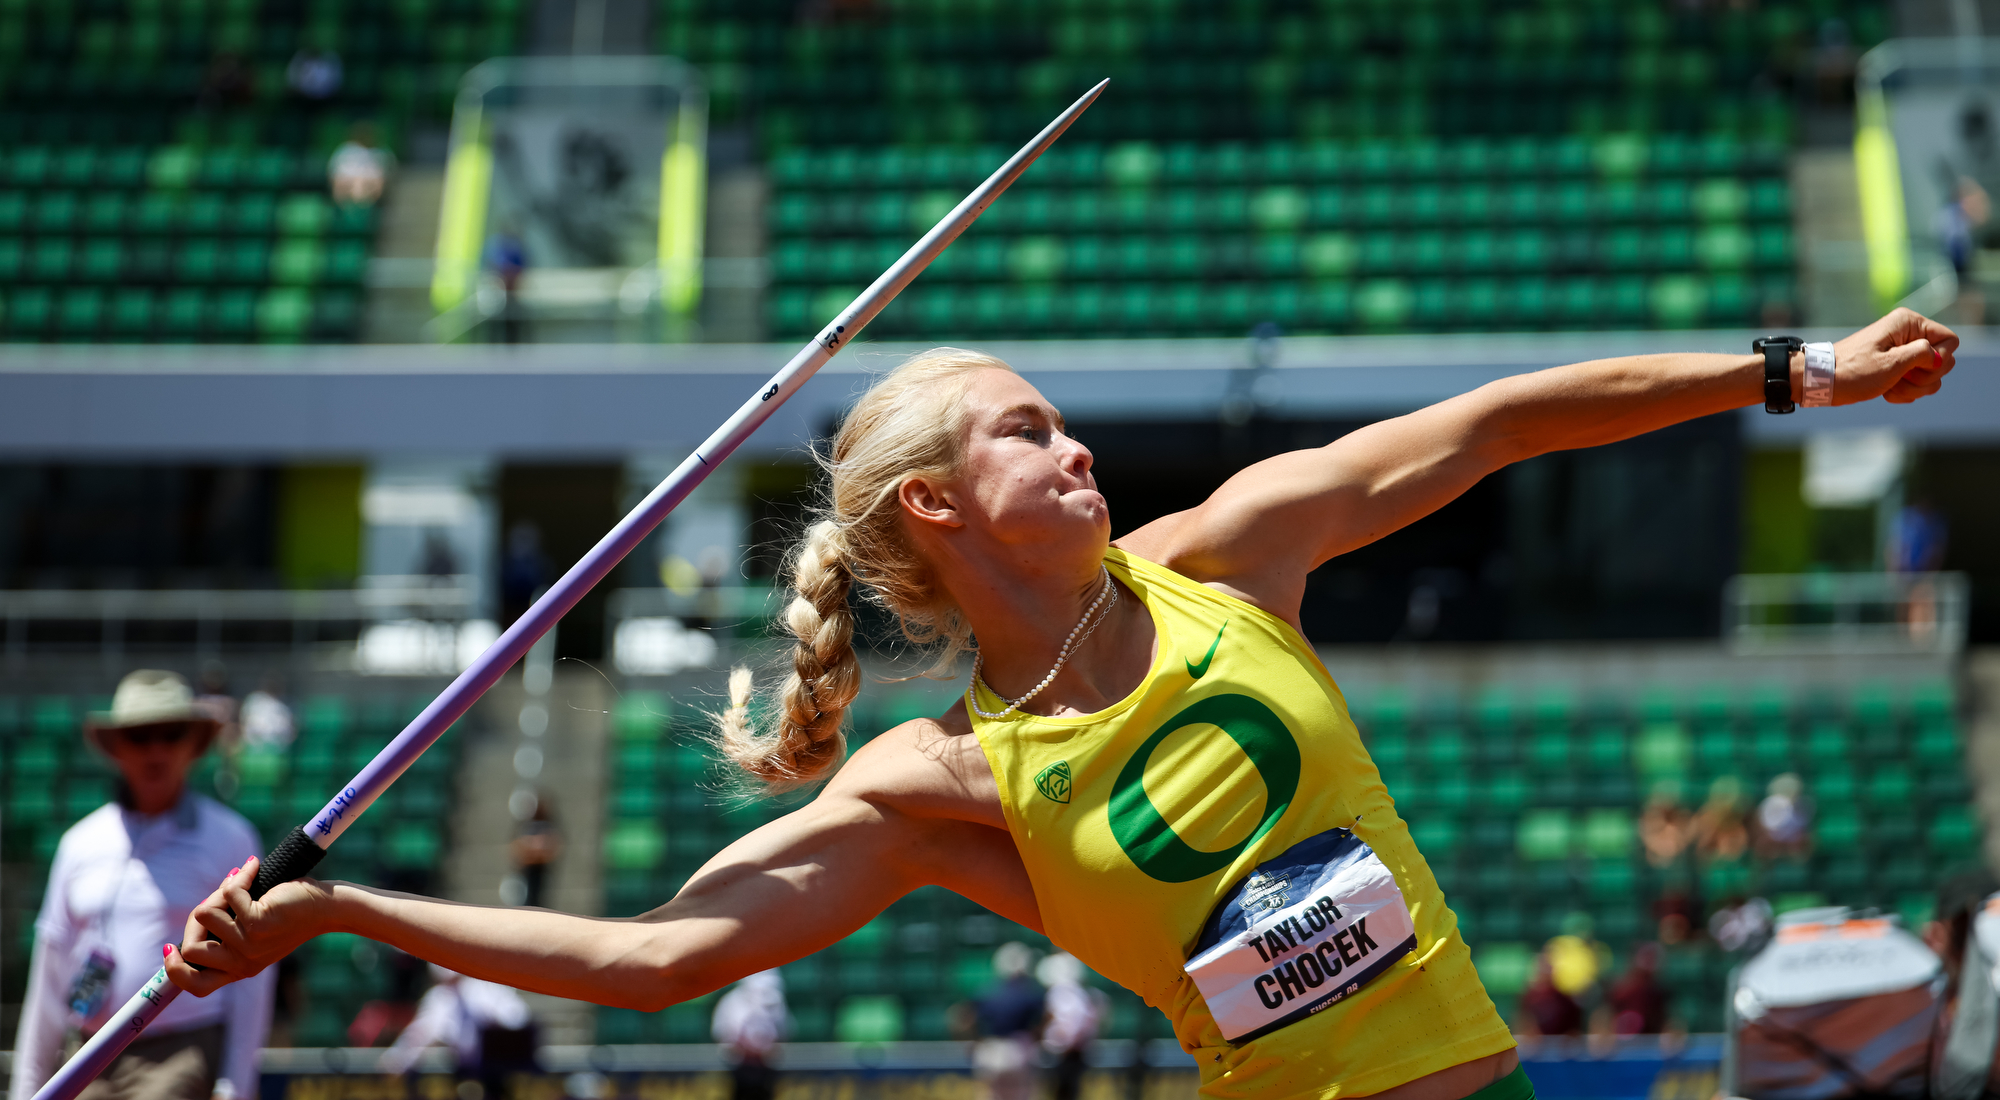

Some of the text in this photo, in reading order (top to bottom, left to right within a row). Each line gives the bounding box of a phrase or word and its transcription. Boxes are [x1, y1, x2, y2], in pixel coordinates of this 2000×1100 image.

[1036, 762, 1069, 796] PAC
[1049, 778, 1069, 800] 12
[315, 787, 356, 836] #240
[1248, 894, 1343, 964] TAYLOR
[1253, 916, 1379, 1010] CHOCEK
